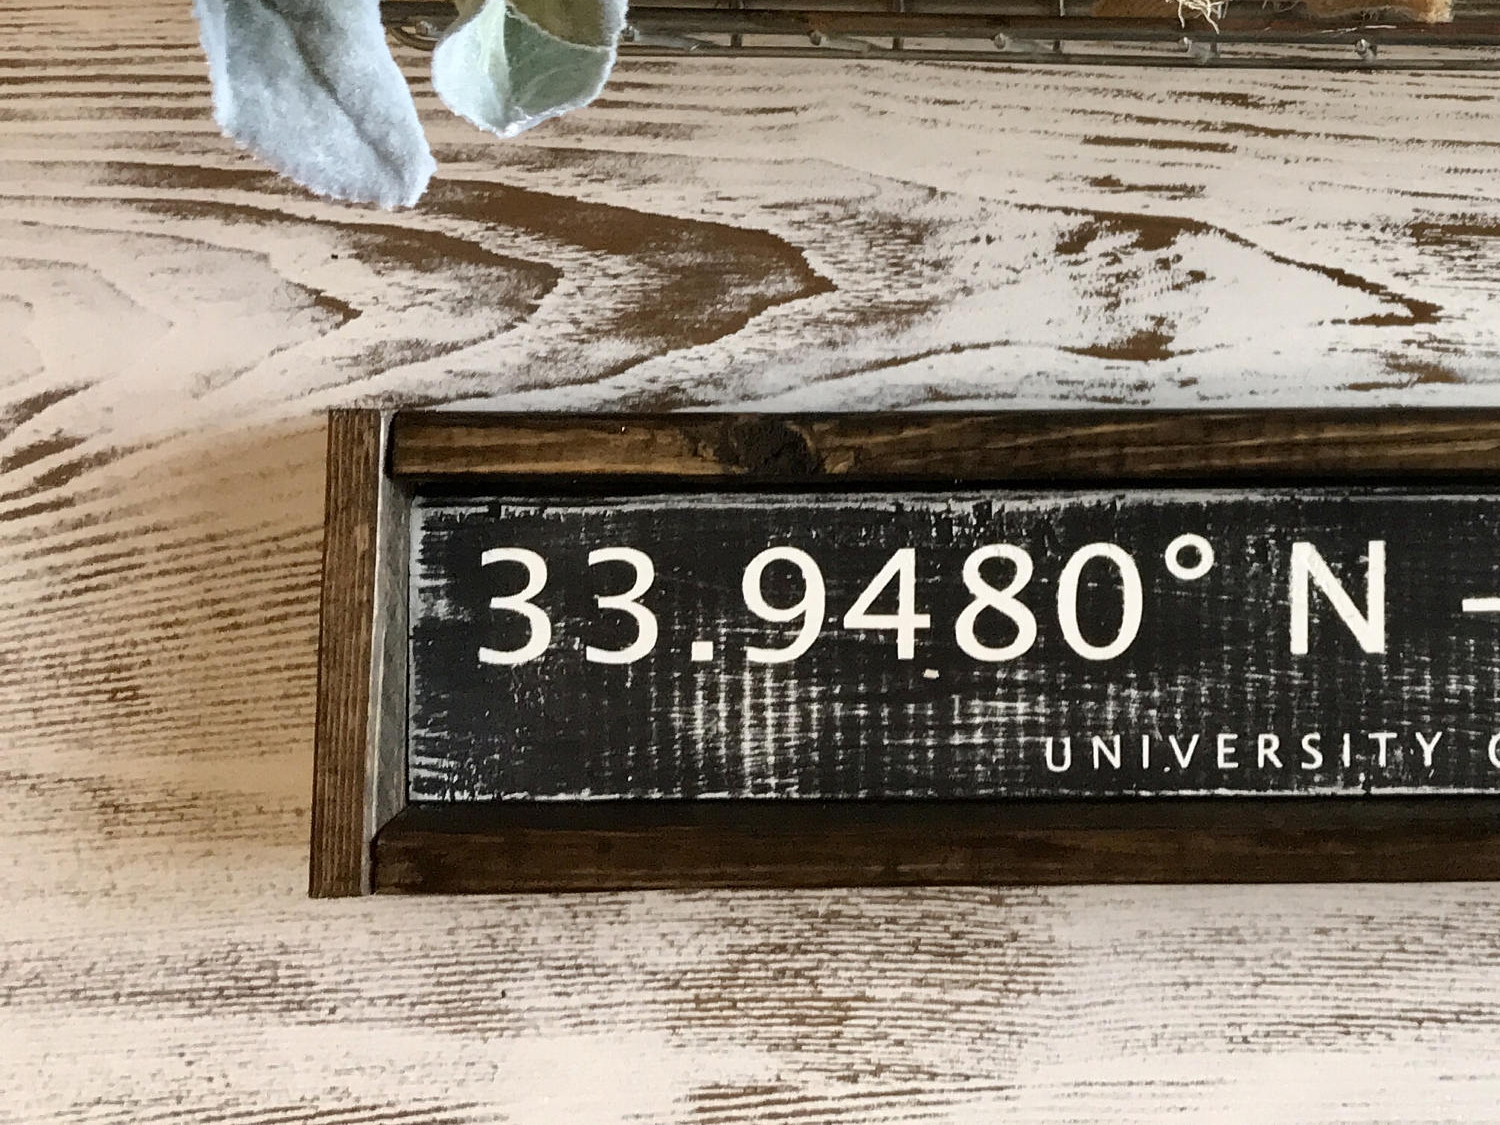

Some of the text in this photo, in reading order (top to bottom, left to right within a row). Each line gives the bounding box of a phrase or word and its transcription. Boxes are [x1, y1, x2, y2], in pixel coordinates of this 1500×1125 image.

[477, 532, 1215, 666] 33.9480°
[1289, 539, 1386, 655] N
[1045, 730, 1444, 774] UNIVERSITY
